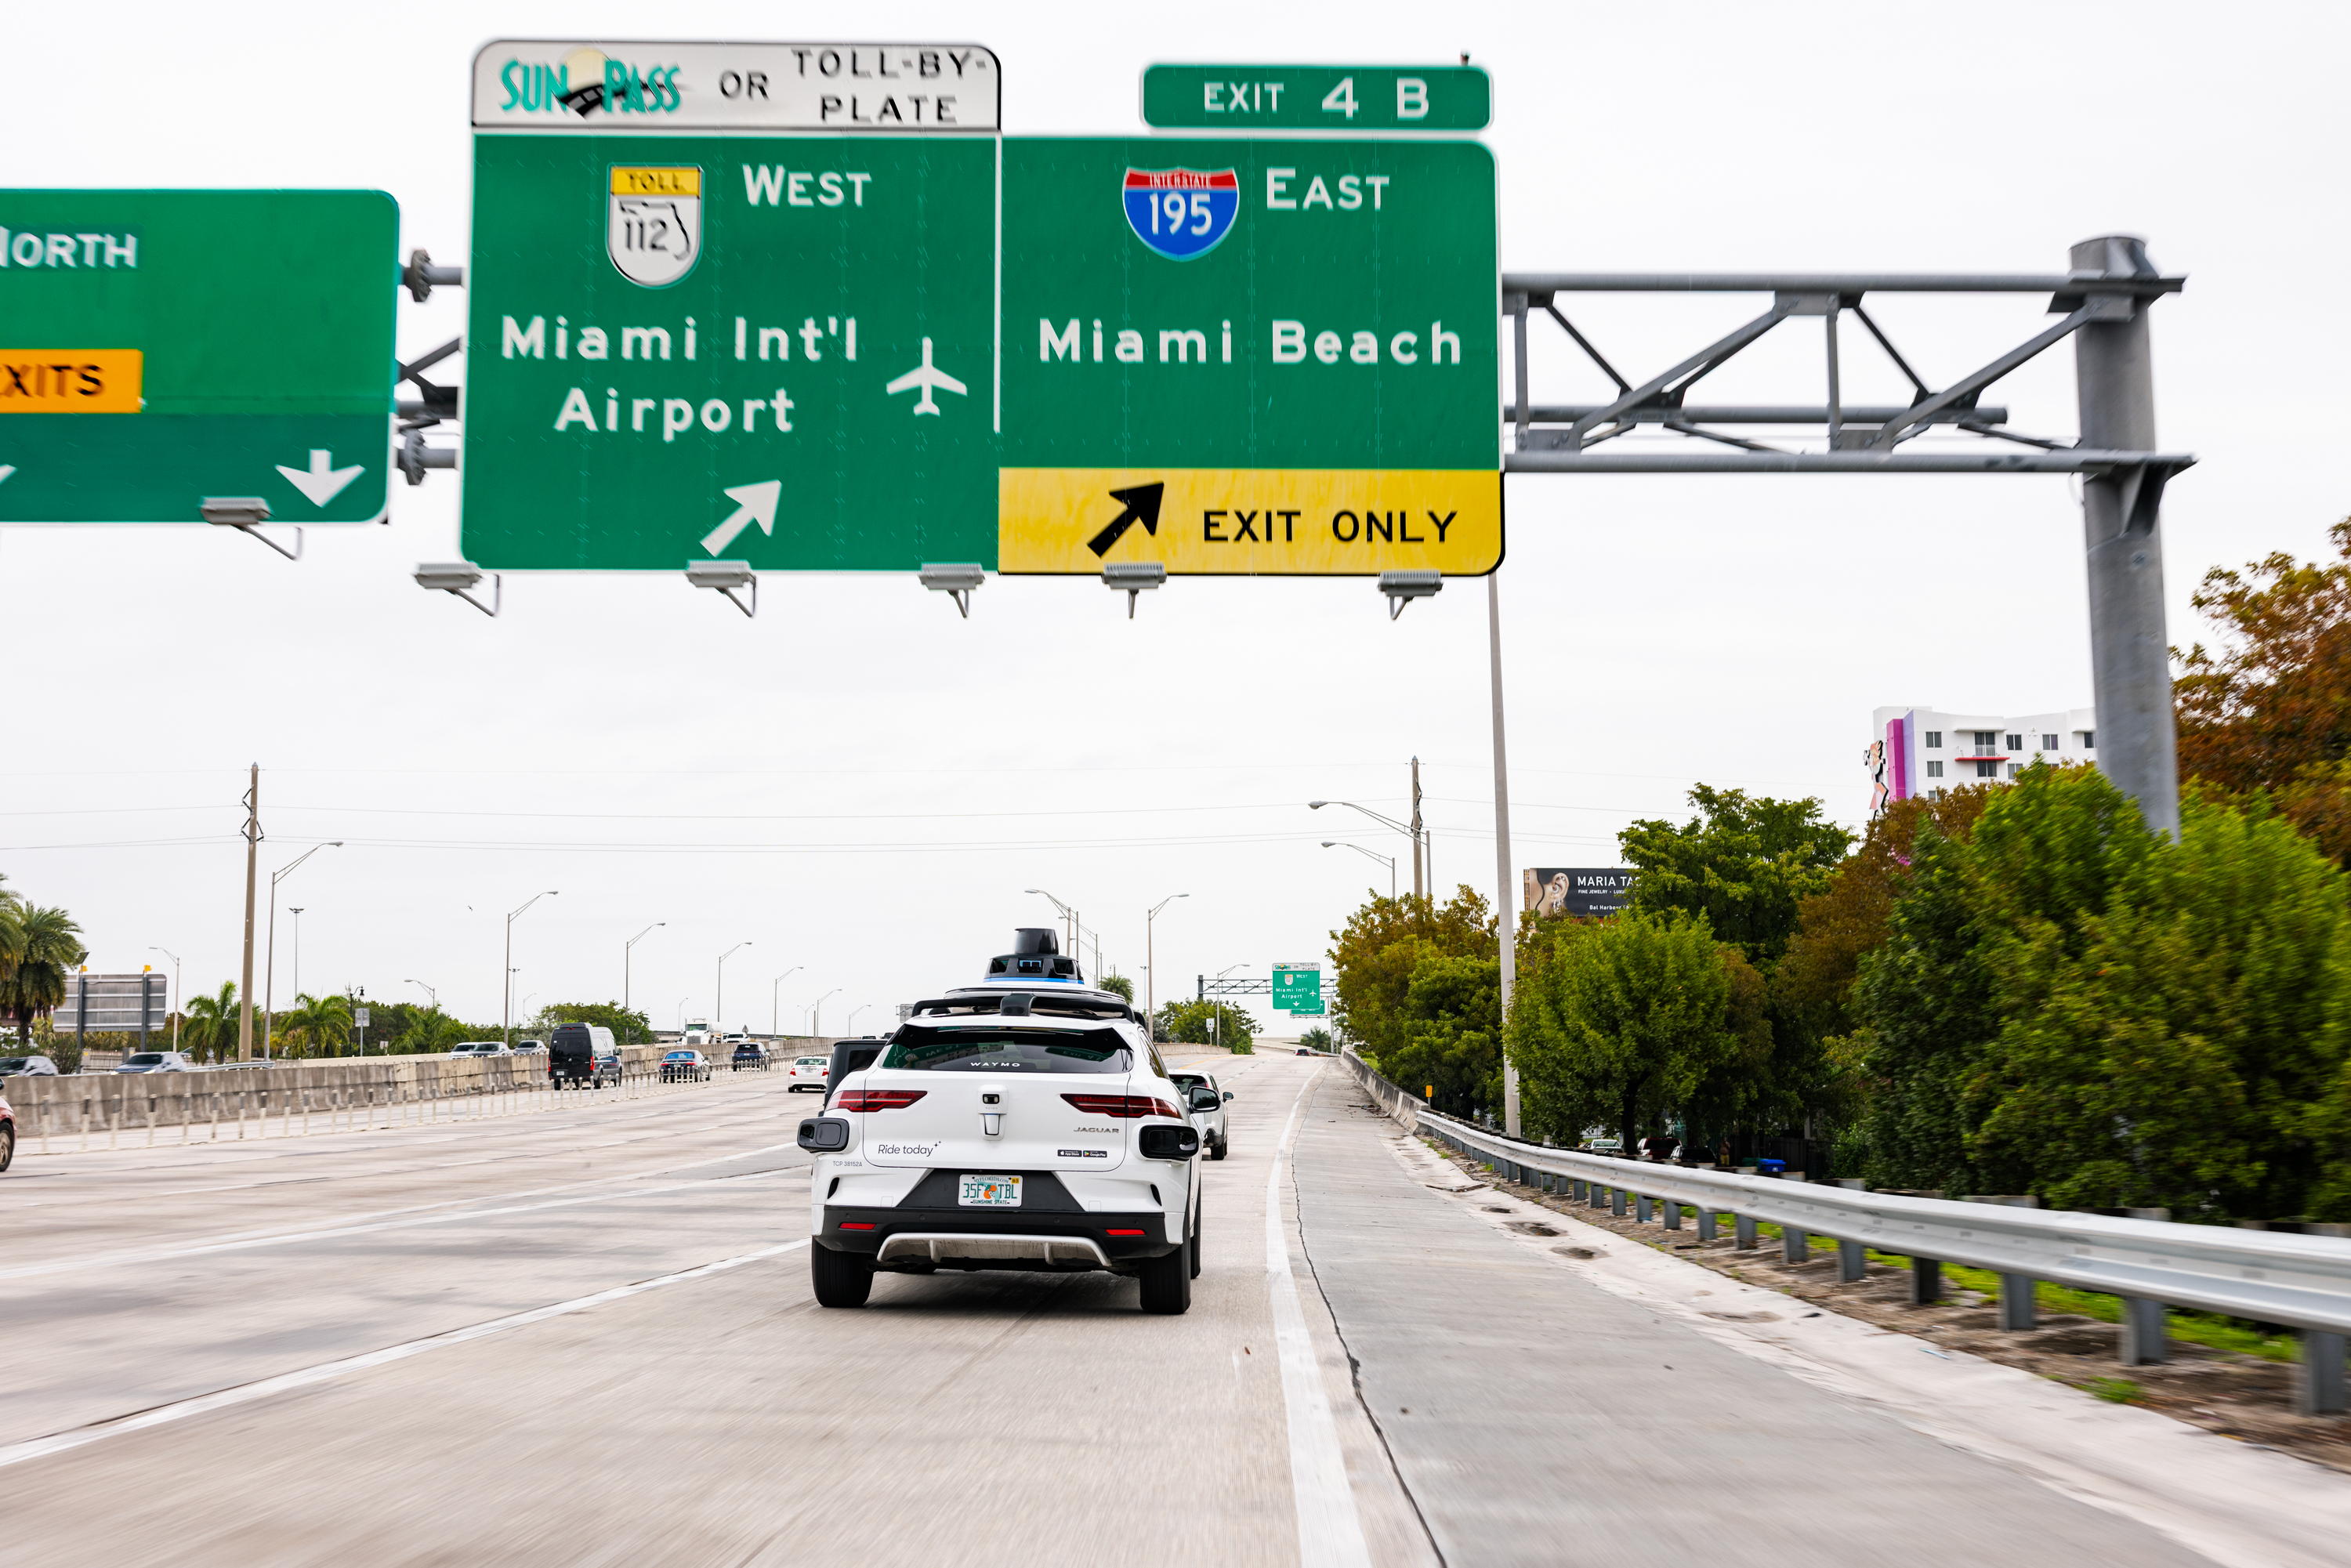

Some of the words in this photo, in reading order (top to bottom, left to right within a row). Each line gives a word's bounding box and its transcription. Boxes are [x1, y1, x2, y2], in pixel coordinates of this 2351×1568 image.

[719, 71, 770, 101] OR
[1204, 81, 1284, 114] EXIT
[1321, 76, 1359, 121] 4
[1396, 76, 1429, 121] B
[820, 94, 958, 124] PLATE
[625, 171, 688, 193] TOLL
[741, 164, 872, 208] WEST
[1149, 172, 1212, 190] INTERSTATE
[1266, 167, 1390, 211] EAST
[1149, 192, 1213, 237] 195
[624, 217, 669, 252] 112
[502, 314, 697, 360] Miami
[734, 316, 857, 363] Int'l
[1039, 317, 1233, 364] Miami
[1272, 318, 1462, 366] Beach
[0, 363, 107, 397] XITS
[553, 386, 795, 444] Airport
[1204, 509, 1302, 544] EXIT
[1331, 509, 1459, 545] ONLY
[1578, 876, 1616, 886] MARIA
[878, 1144, 900, 1154] Ride
[903, 1144, 933, 1157] today
[998, 1184, 1018, 1199] TBL
